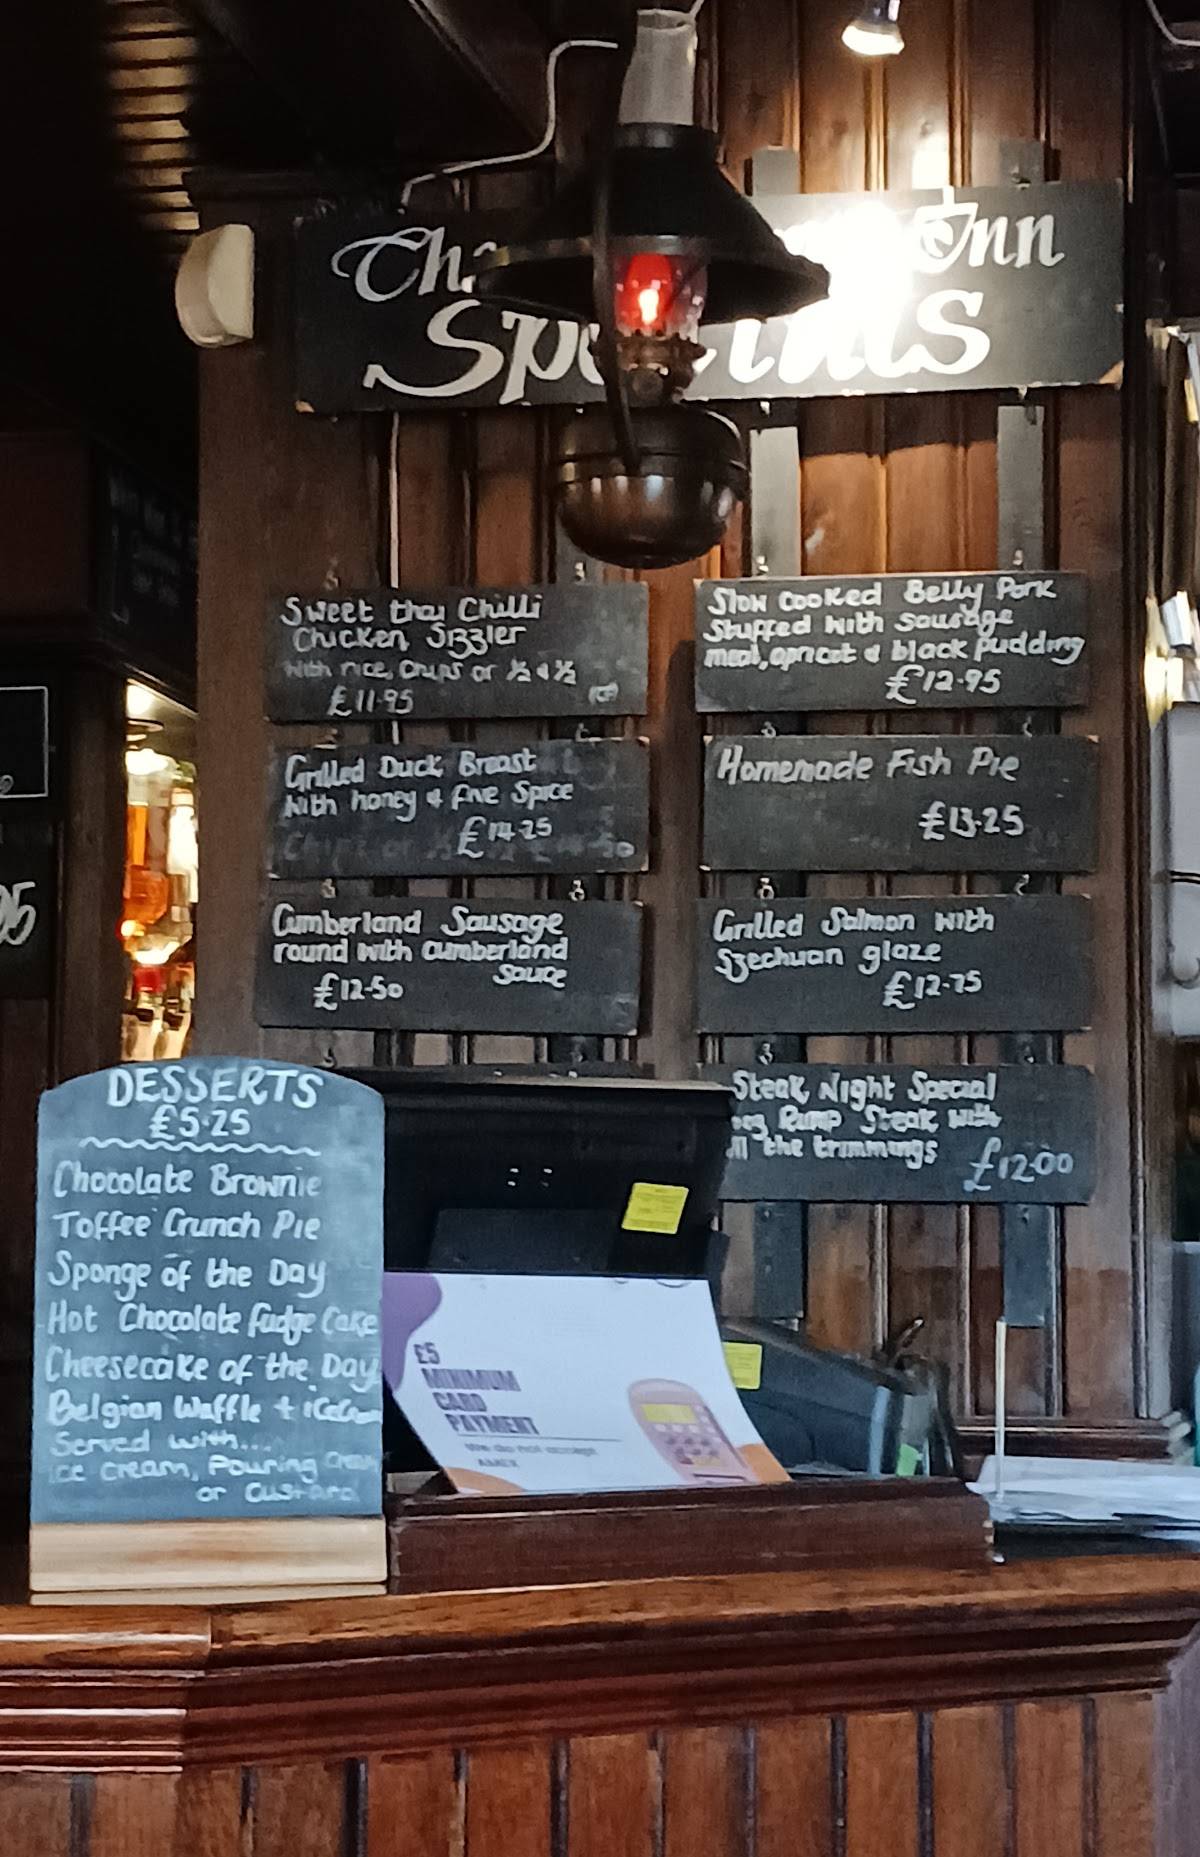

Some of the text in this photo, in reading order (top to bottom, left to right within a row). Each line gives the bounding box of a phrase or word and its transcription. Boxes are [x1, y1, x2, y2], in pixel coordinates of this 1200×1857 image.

[280, 596, 375, 627] Sweet
[458, 594, 543, 623] Chilli
[707, 587, 767, 616] Slow
[903, 578, 984, 616] Belly
[996, 576, 1057, 601] Pork
[293, 623, 527, 660] Chicken Sizzler
[703, 614, 812, 643] Stuffed
[824, 610, 884, 636] with
[890, 638, 969, 663] black
[974, 630, 1085, 665] pudding
[470, 663, 499, 681] or
[285, 748, 538, 791] Grilled Duck Breast
[717, 743, 1020, 786] Homemade Fish Pie
[350, 789, 418, 823] honey
[272, 902, 565, 945] Cumberland Sausage
[712, 906, 995, 942] Grilled Salmon with
[273, 938, 349, 964] round
[357, 939, 413, 963] with
[715, 940, 942, 984] Szechuan glaze
[106, 1065, 324, 1109] DESSERTS
[732, 1069, 811, 1105] Steak
[818, 1071, 895, 1113] Night
[860, 1106, 940, 1135] Steak
[763, 1134, 804, 1158] the
[812, 1135, 938, 1170] trimmings
[53, 1159, 323, 1198] Chocolate Brownie
[52, 1207, 323, 1241] Toffee Crunch Pie
[47, 1250, 328, 1302] Sponge of the Day
[47, 1299, 99, 1335] Hot
[118, 1302, 243, 1335] Chocolate
[321, 1305, 380, 1337] Cake
[45, 1345, 382, 1394] Cheesecake of the Day
[414, 1342, 441, 1365] £5
[48, 1388, 164, 1430] Belgian
[172, 1393, 262, 1425] Waffle
[432, 1392, 488, 1412] CARD
[444, 1414, 539, 1436] PAYMENT
[50, 1429, 151, 1458] Served
[196, 1486, 228, 1503] or
